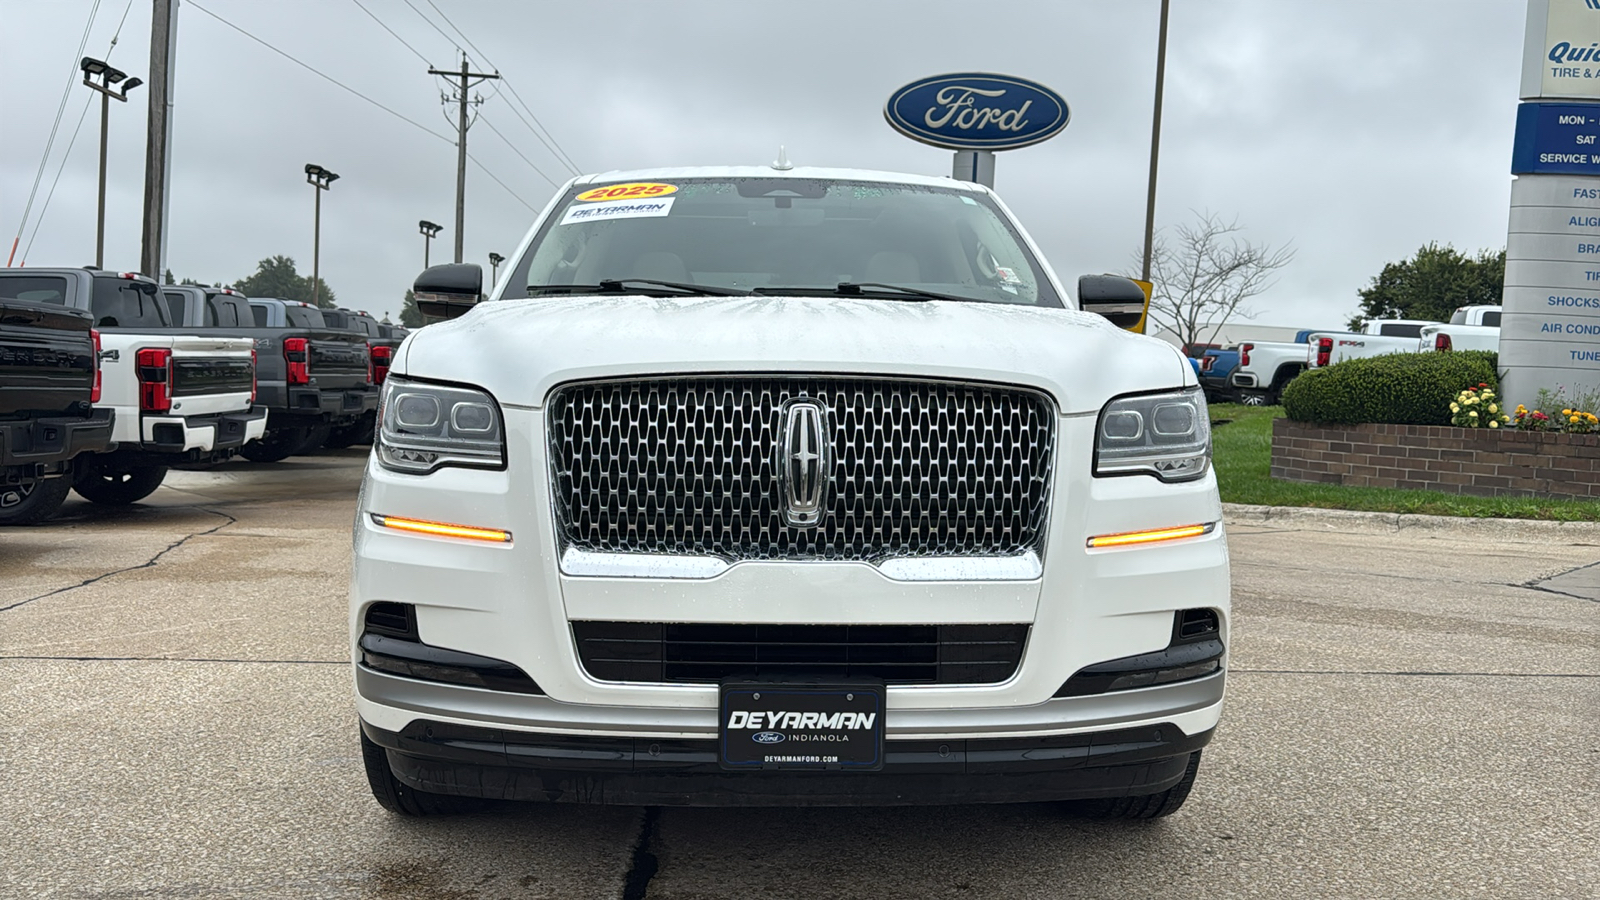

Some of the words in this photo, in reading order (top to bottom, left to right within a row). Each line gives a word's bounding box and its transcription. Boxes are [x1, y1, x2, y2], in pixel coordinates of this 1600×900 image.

[1551, 67, 1580, 78] TIRE
[1583, 68, 1593, 78] &
[924, 85, 1033, 132] Ford
[1558, 115, 1585, 125] MON
[1576, 134, 1597, 145] SAT
[1539, 153, 1587, 164] SERVICE
[584, 185, 668, 200] 2025
[571, 203, 666, 217] DEYARMAN
[1568, 216, 1600, 227] ALIG
[1541, 322, 1562, 333] AIR
[1566, 323, 1600, 335] COND
[1570, 350, 1600, 361] TUNE
[727, 711, 876, 730] DEYARMAN
[788, 734, 850, 742] INDIANOLA
[764, 755, 838, 763] DEYARMANFORD.COM
